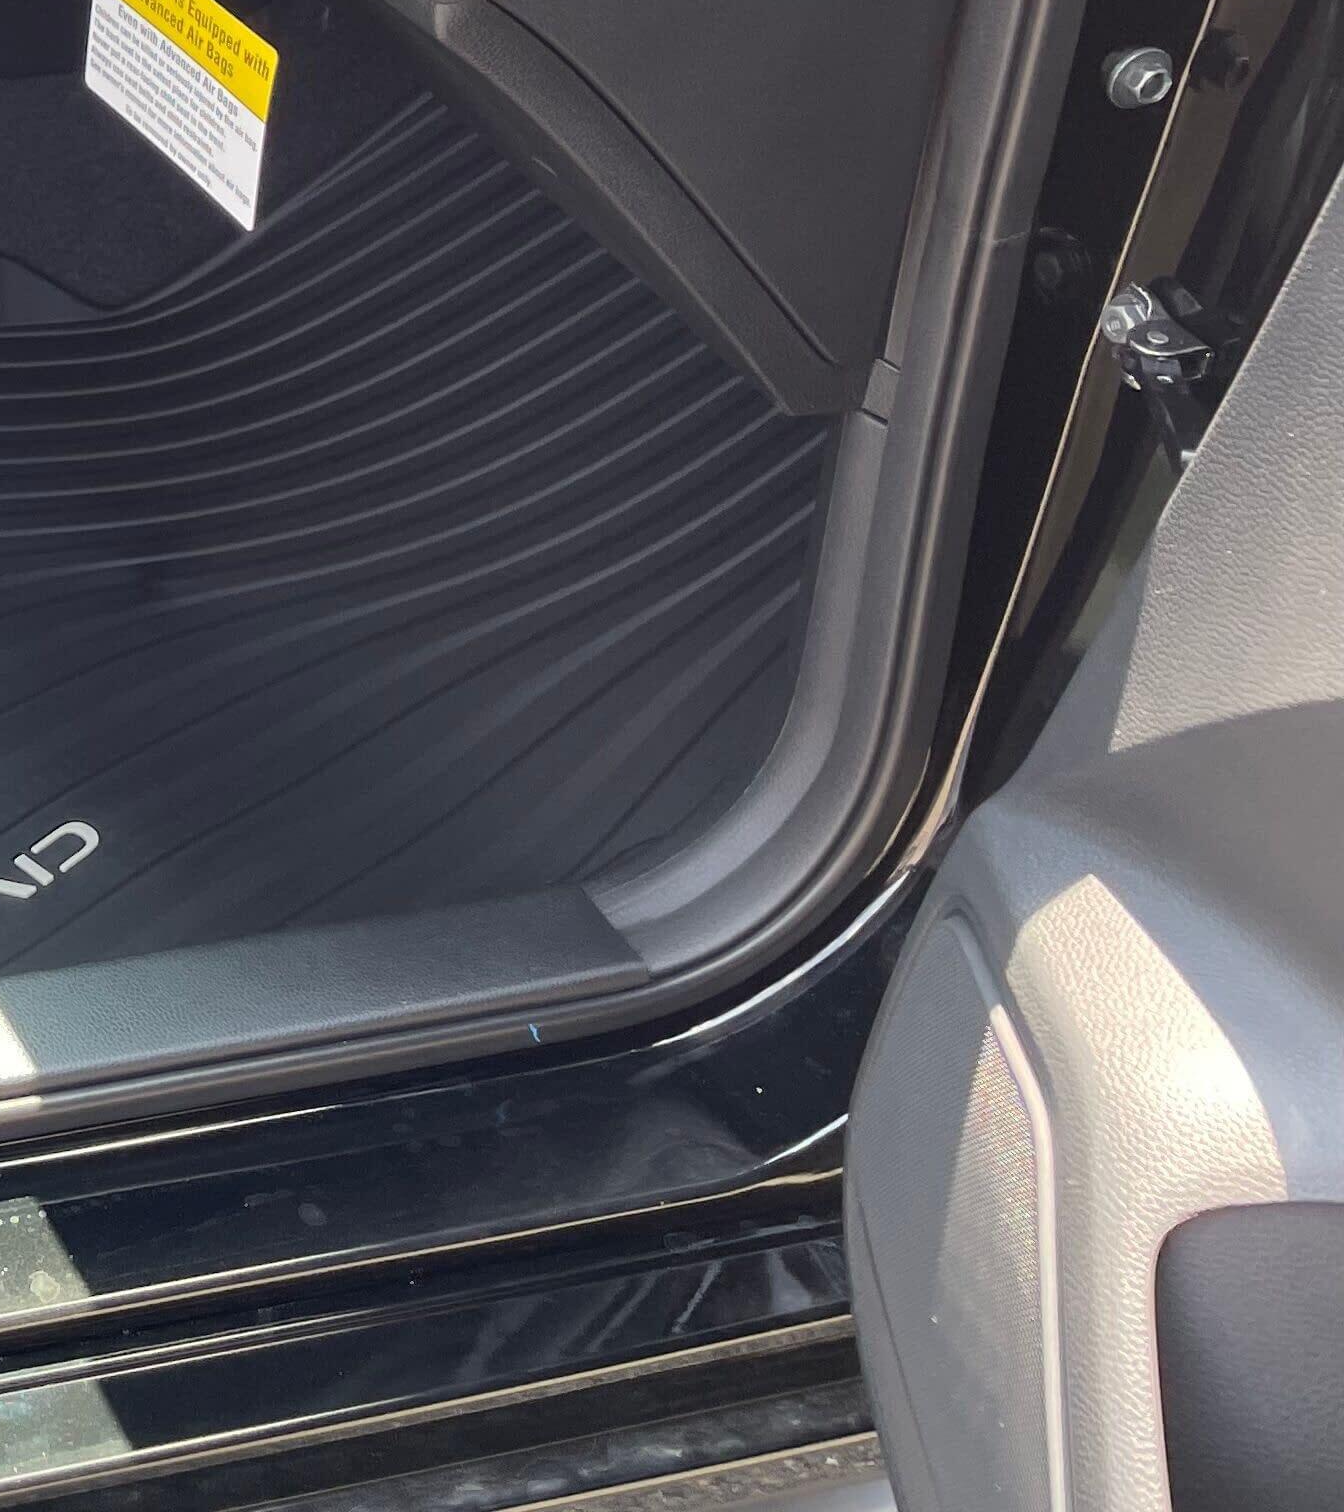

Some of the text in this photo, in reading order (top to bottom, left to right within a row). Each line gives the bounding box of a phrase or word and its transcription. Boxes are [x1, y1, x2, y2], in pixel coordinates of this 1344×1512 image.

[118, 5, 238, 117] Even with Advanced Air Bags
[186, 25, 204, 51] Air
[205, 41, 234, 79] Bags
[187, 0, 241, 57] Equipped
[243, 47, 270, 81] with
